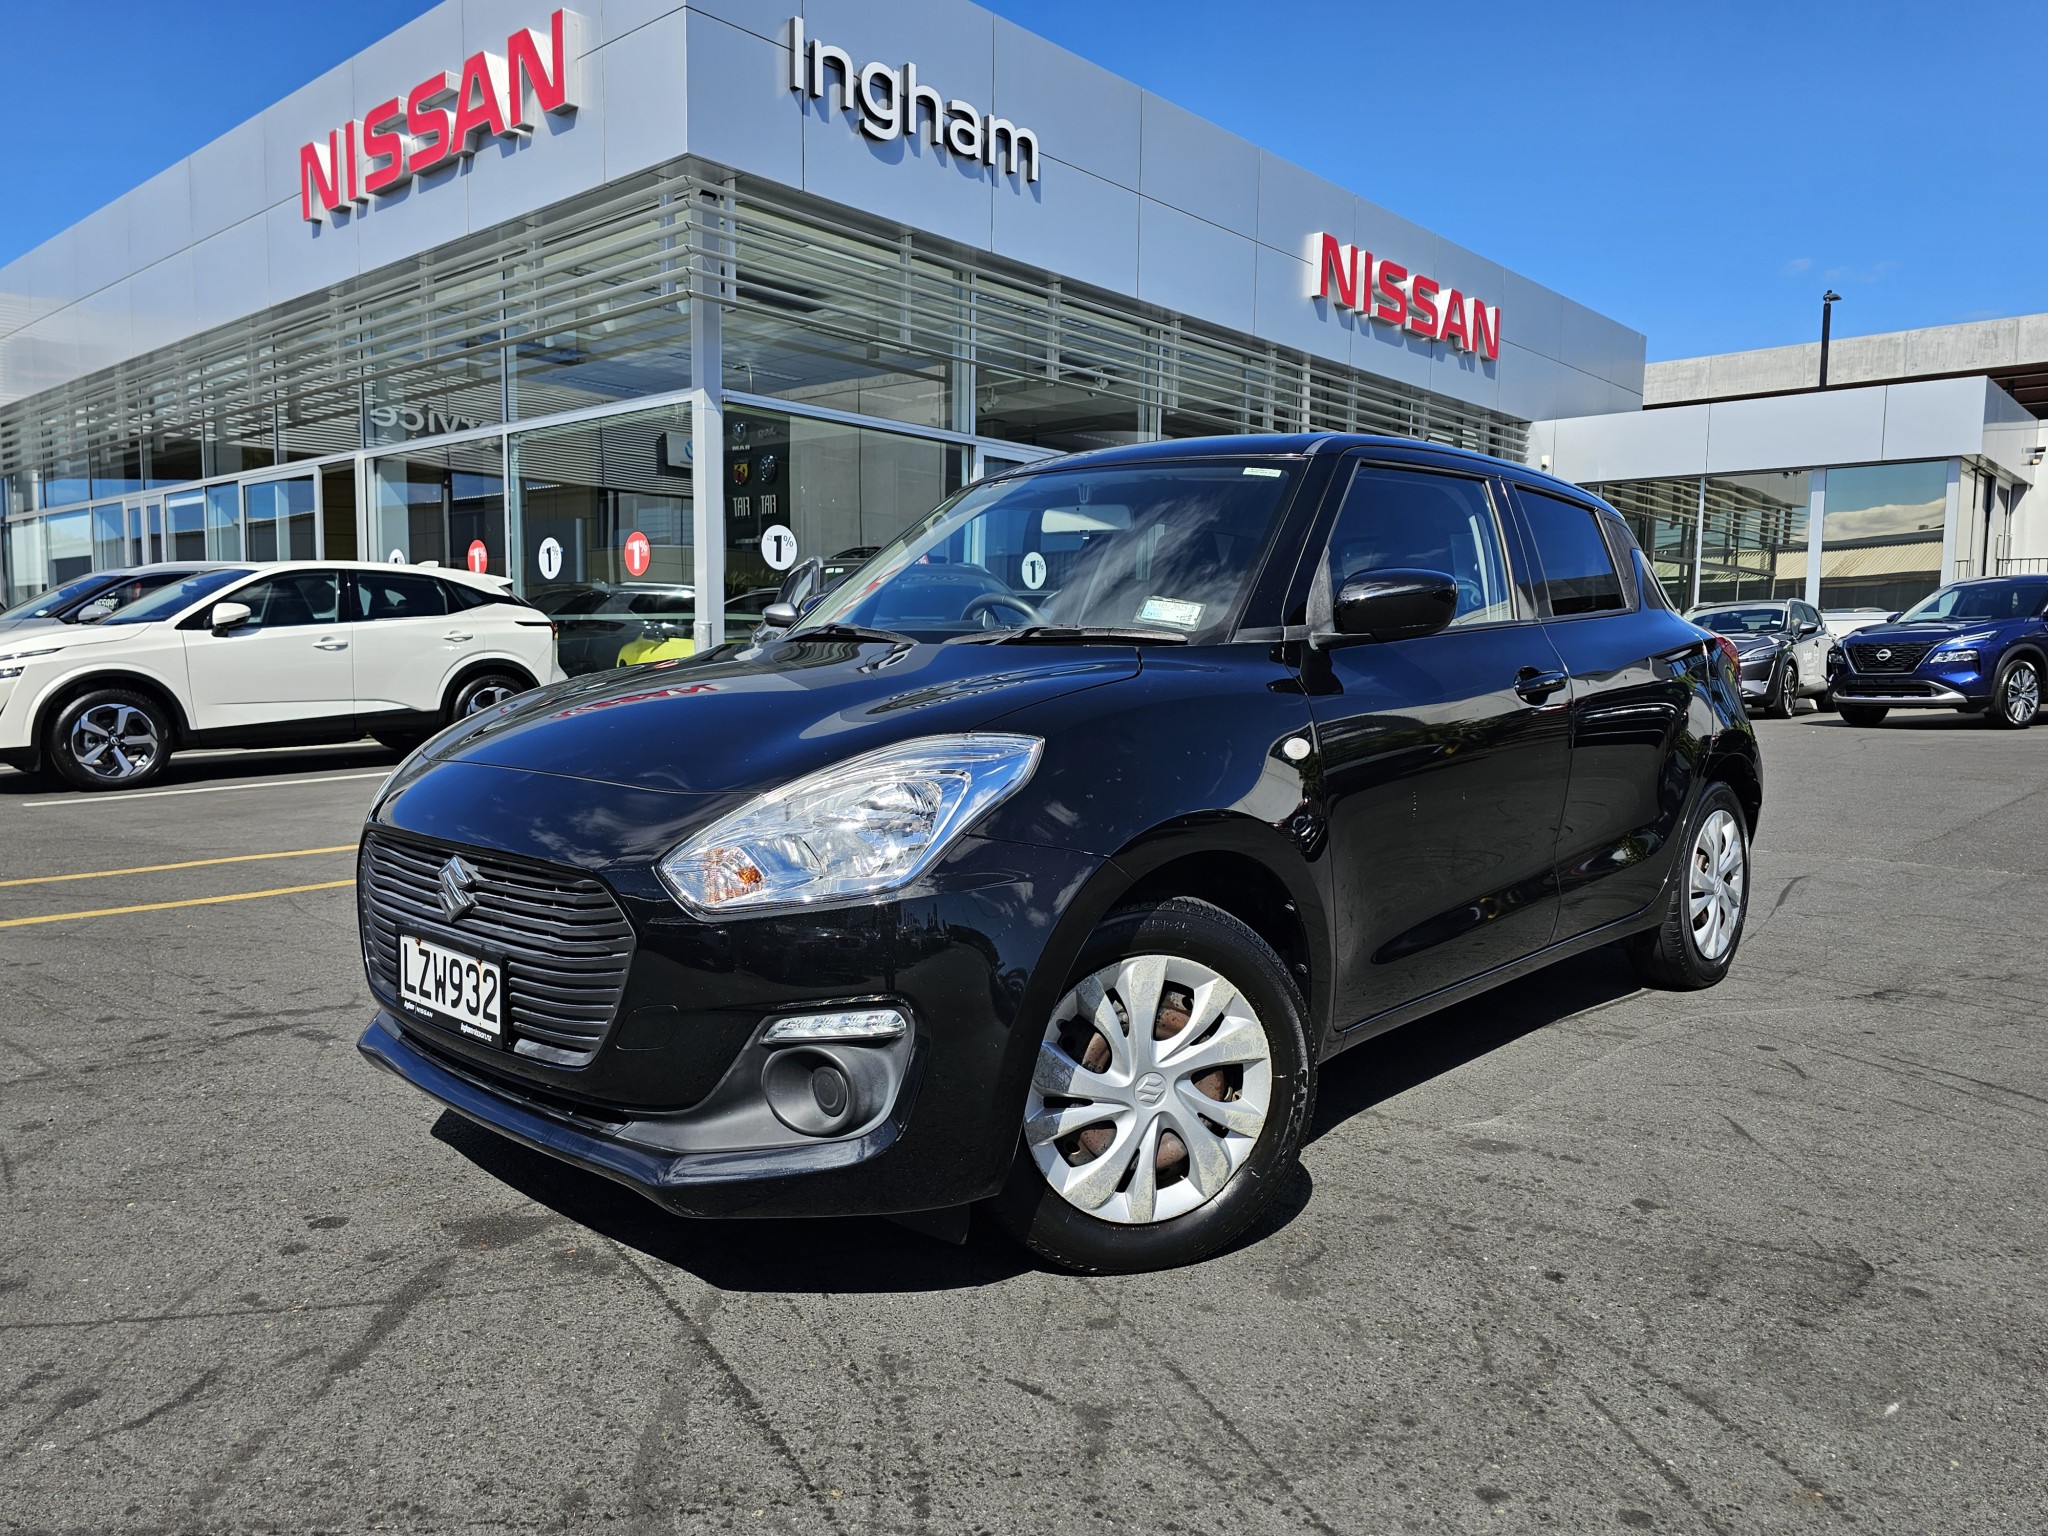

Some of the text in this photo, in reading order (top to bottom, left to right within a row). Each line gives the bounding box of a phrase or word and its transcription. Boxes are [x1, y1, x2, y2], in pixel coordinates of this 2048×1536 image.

[300, 8, 570, 222] NISSAN
[789, 16, 1039, 182] Ingham
[1316, 232, 1501, 360] NISSAN
[402, 942, 498, 1024] LZW932
[416, 1006, 434, 1018] NISSAN
